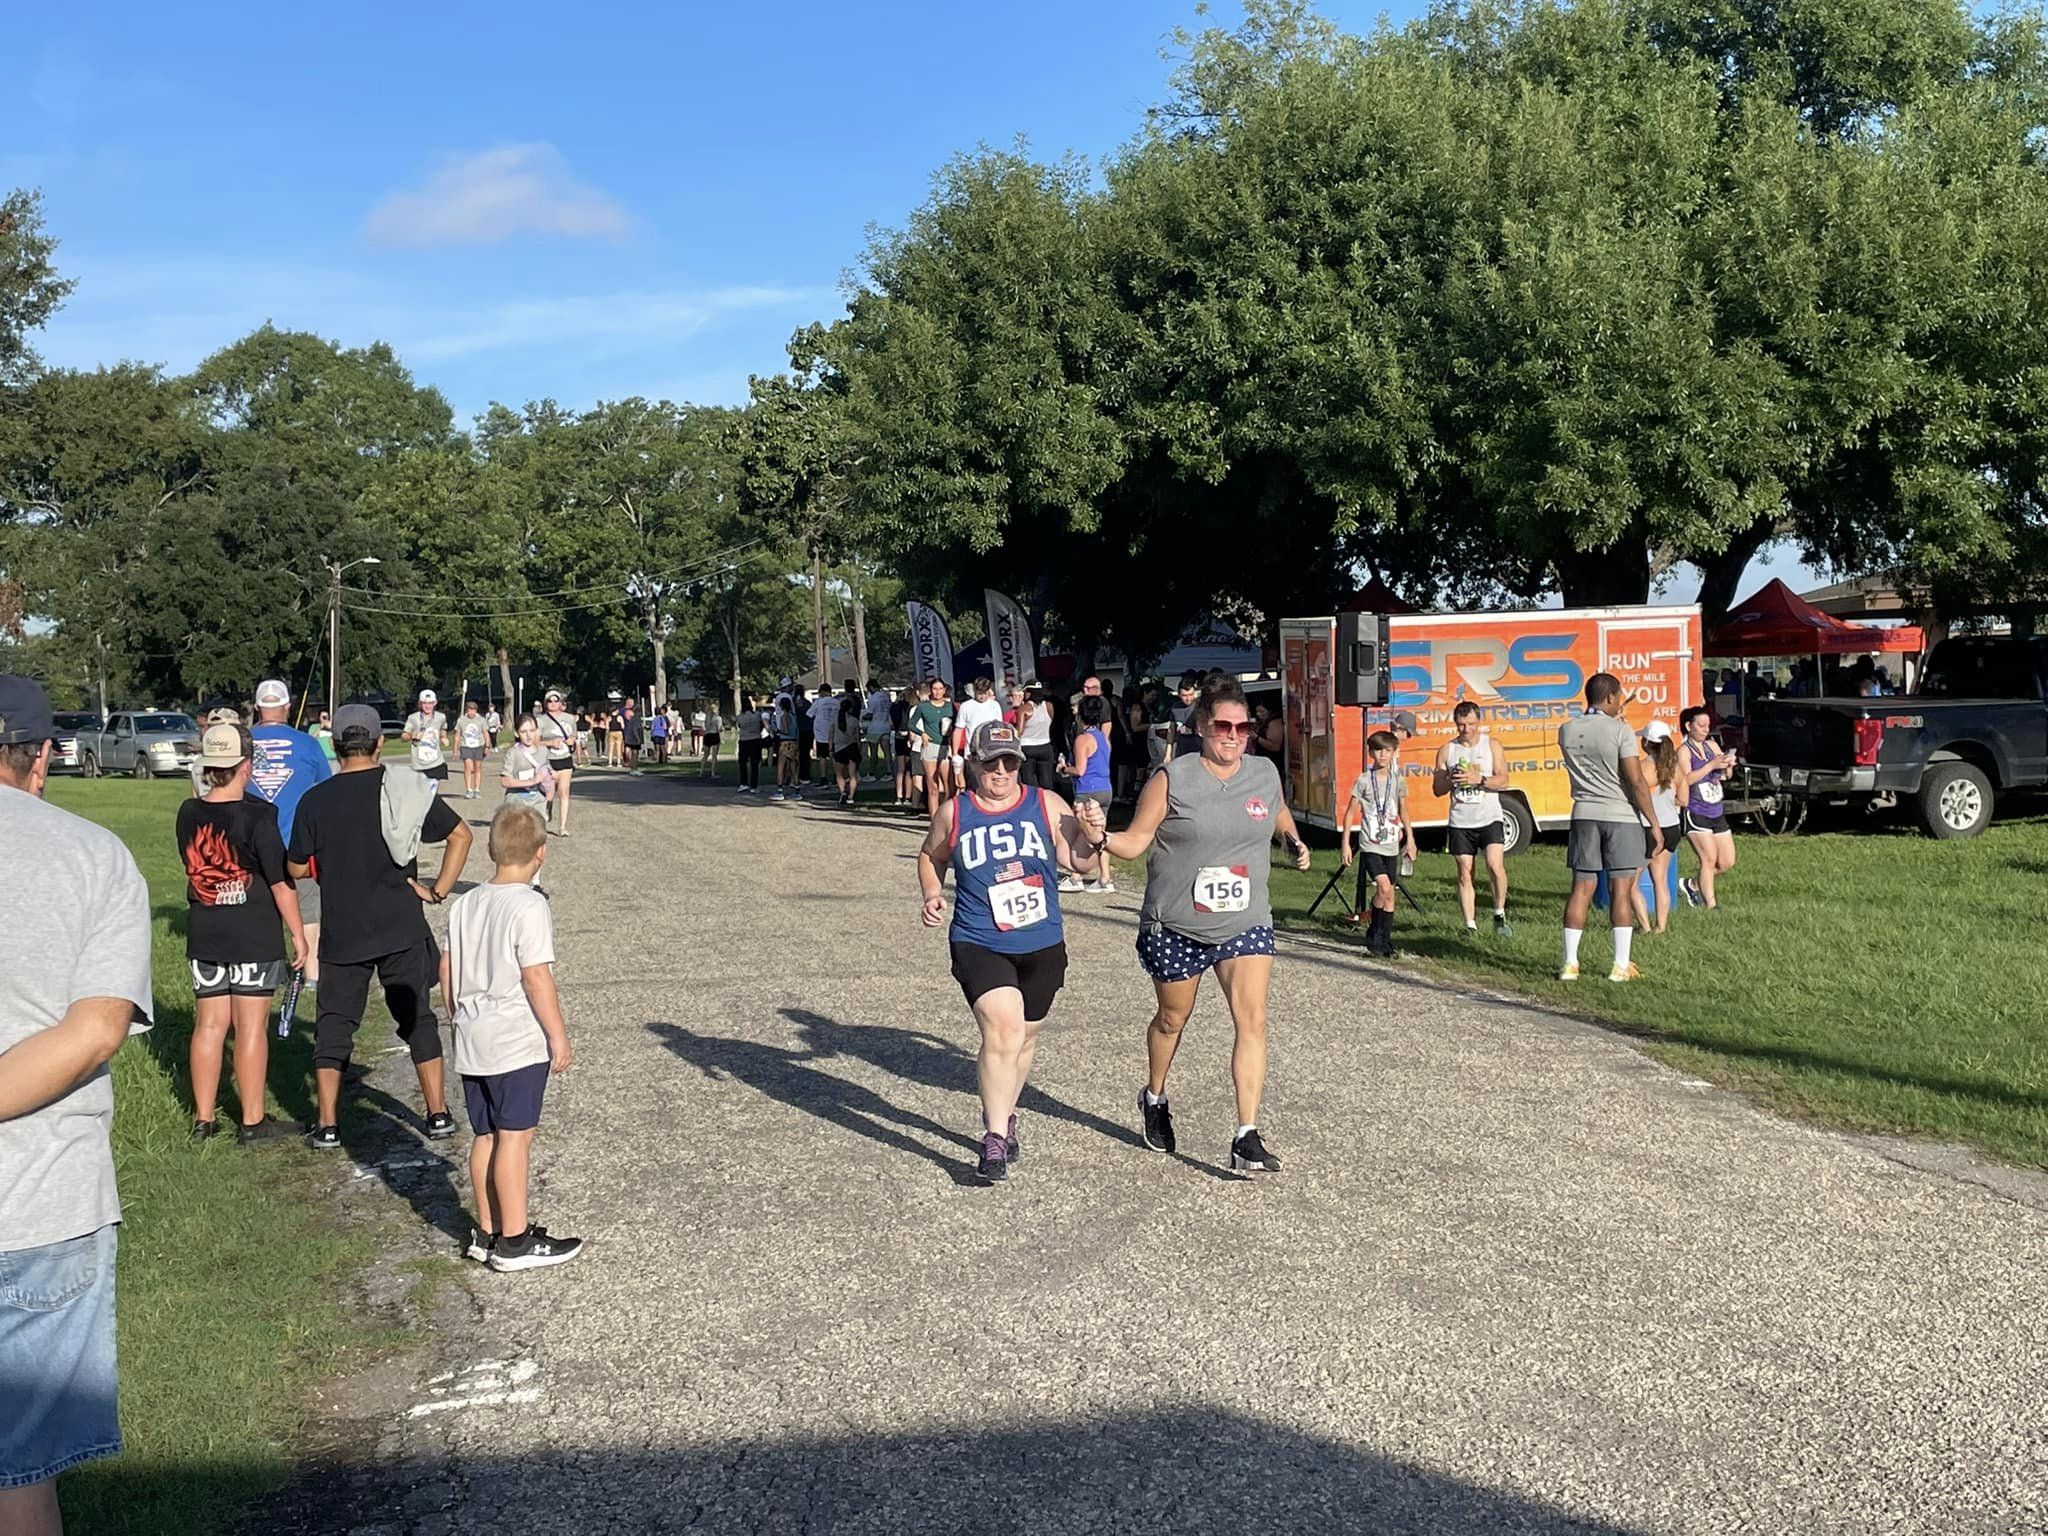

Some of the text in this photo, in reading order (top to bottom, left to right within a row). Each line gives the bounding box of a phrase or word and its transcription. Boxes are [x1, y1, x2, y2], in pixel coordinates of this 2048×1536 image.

[919, 621, 936, 673] WORX
[998, 613, 1014, 671] WORX
[1608, 653, 1651, 670] RUN
[1622, 673, 1667, 682] THE MILE
[1621, 686, 1668, 704] YOU
[1479, 702, 1584, 720] TRIDERS
[1652, 707, 1678, 717] ARE
[959, 820, 1049, 870] USA
[1204, 880, 1244, 900] 156
[1002, 891, 1040, 916] 155
